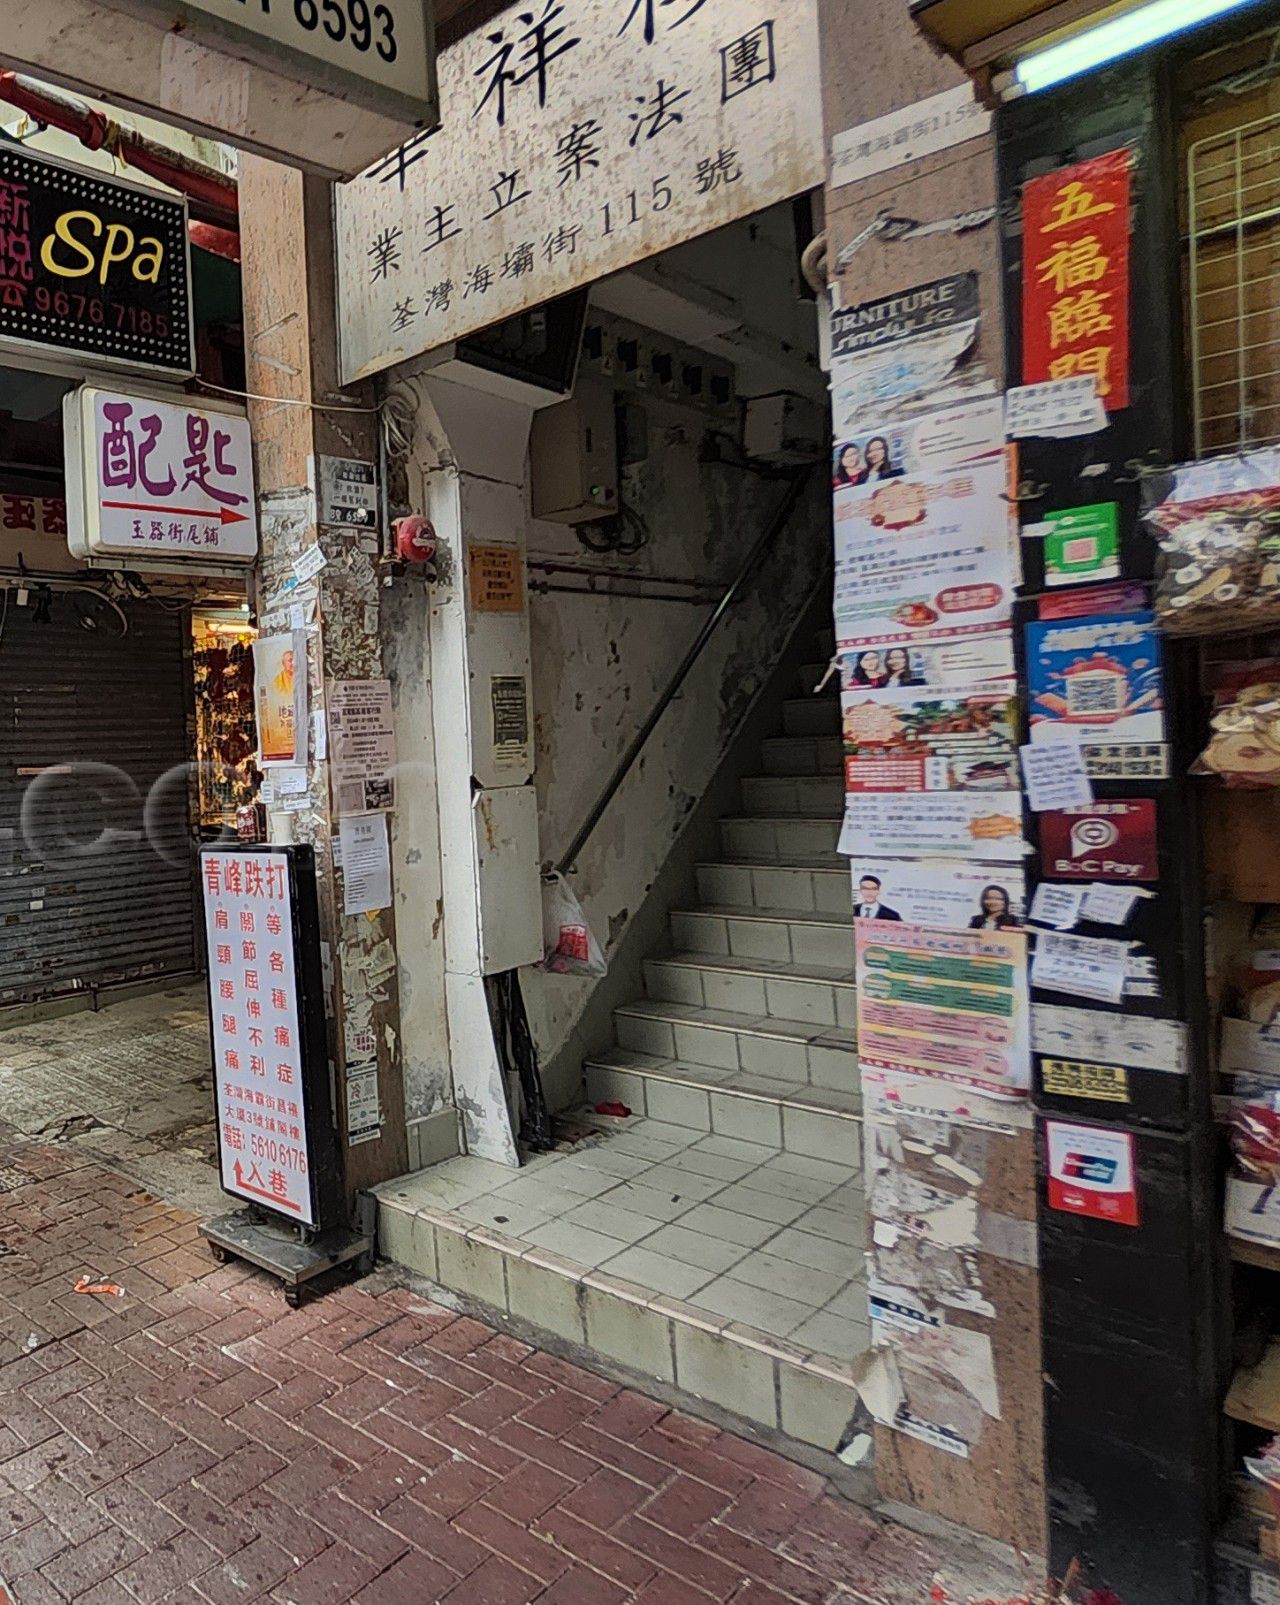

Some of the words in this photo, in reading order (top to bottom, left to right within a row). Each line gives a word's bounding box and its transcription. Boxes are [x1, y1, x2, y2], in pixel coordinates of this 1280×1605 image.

[367, 19, 776, 284] 業主立案法團
[41, 210, 164, 284] Spa
[34, 287, 105, 324] 9676
[111, 304, 168, 337] 7185
[1036, 181, 1115, 396] 五福臨門
[103, 403, 249, 506] 配匙
[204, 857, 285, 901] 青峰跌打
[251, 1133, 278, 1163] 5610
[279, 1143, 307, 1175] 6176
